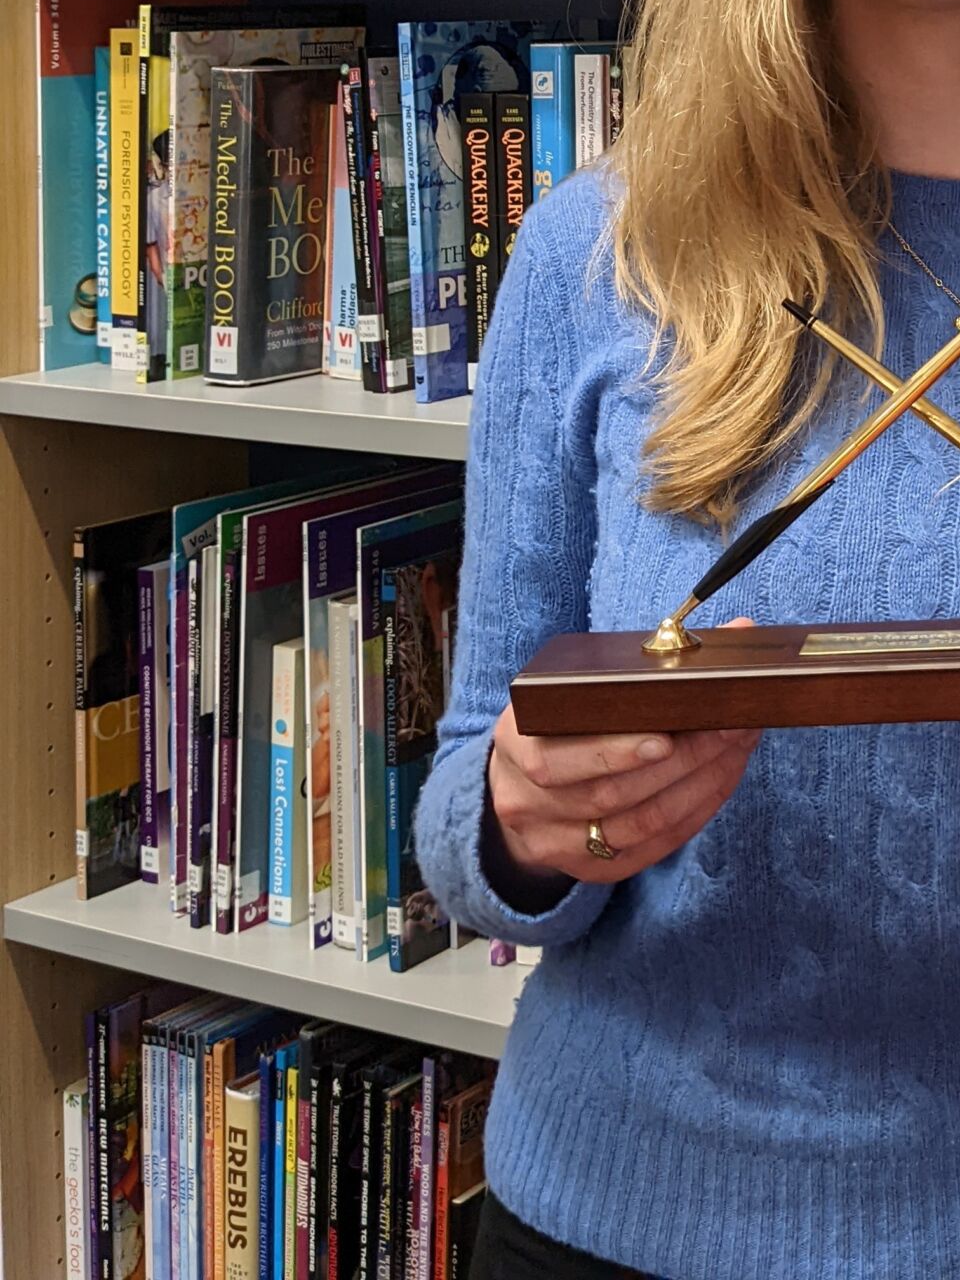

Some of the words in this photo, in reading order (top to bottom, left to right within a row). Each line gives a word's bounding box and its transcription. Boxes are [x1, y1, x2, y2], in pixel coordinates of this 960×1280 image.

[219, 101, 233, 128] The
[406, 121, 414, 167] DISCOVERY
[97, 91, 109, 218] UNNATURAL
[121, 130, 131, 199] FORENSIC
[215, 136, 237, 234] Medical
[408, 171, 415, 179] OF
[466, 129, 489, 227] QUACKERY
[502, 128, 524, 226] QUACKERY
[408, 183, 417, 226] PENICILLIN
[97, 224, 109, 297] CAUSES
[120, 203, 132, 300] PSYCHOLOGY
[214, 245, 234, 326] BOOK
[386, 678, 396, 709] FOOD
[387, 712, 397, 764] ALLERGY
[275, 759, 288, 791] Lost
[274, 796, 288, 894] Connections
[68, 1147, 79, 1172] the
[99, 1119, 108, 1149] NEW
[67, 1178, 82, 1238] gecko's
[100, 1152, 109, 1231] MATERIALS
[228, 1125, 247, 1250] EREBUS
[71, 1243, 83, 1274] foot
